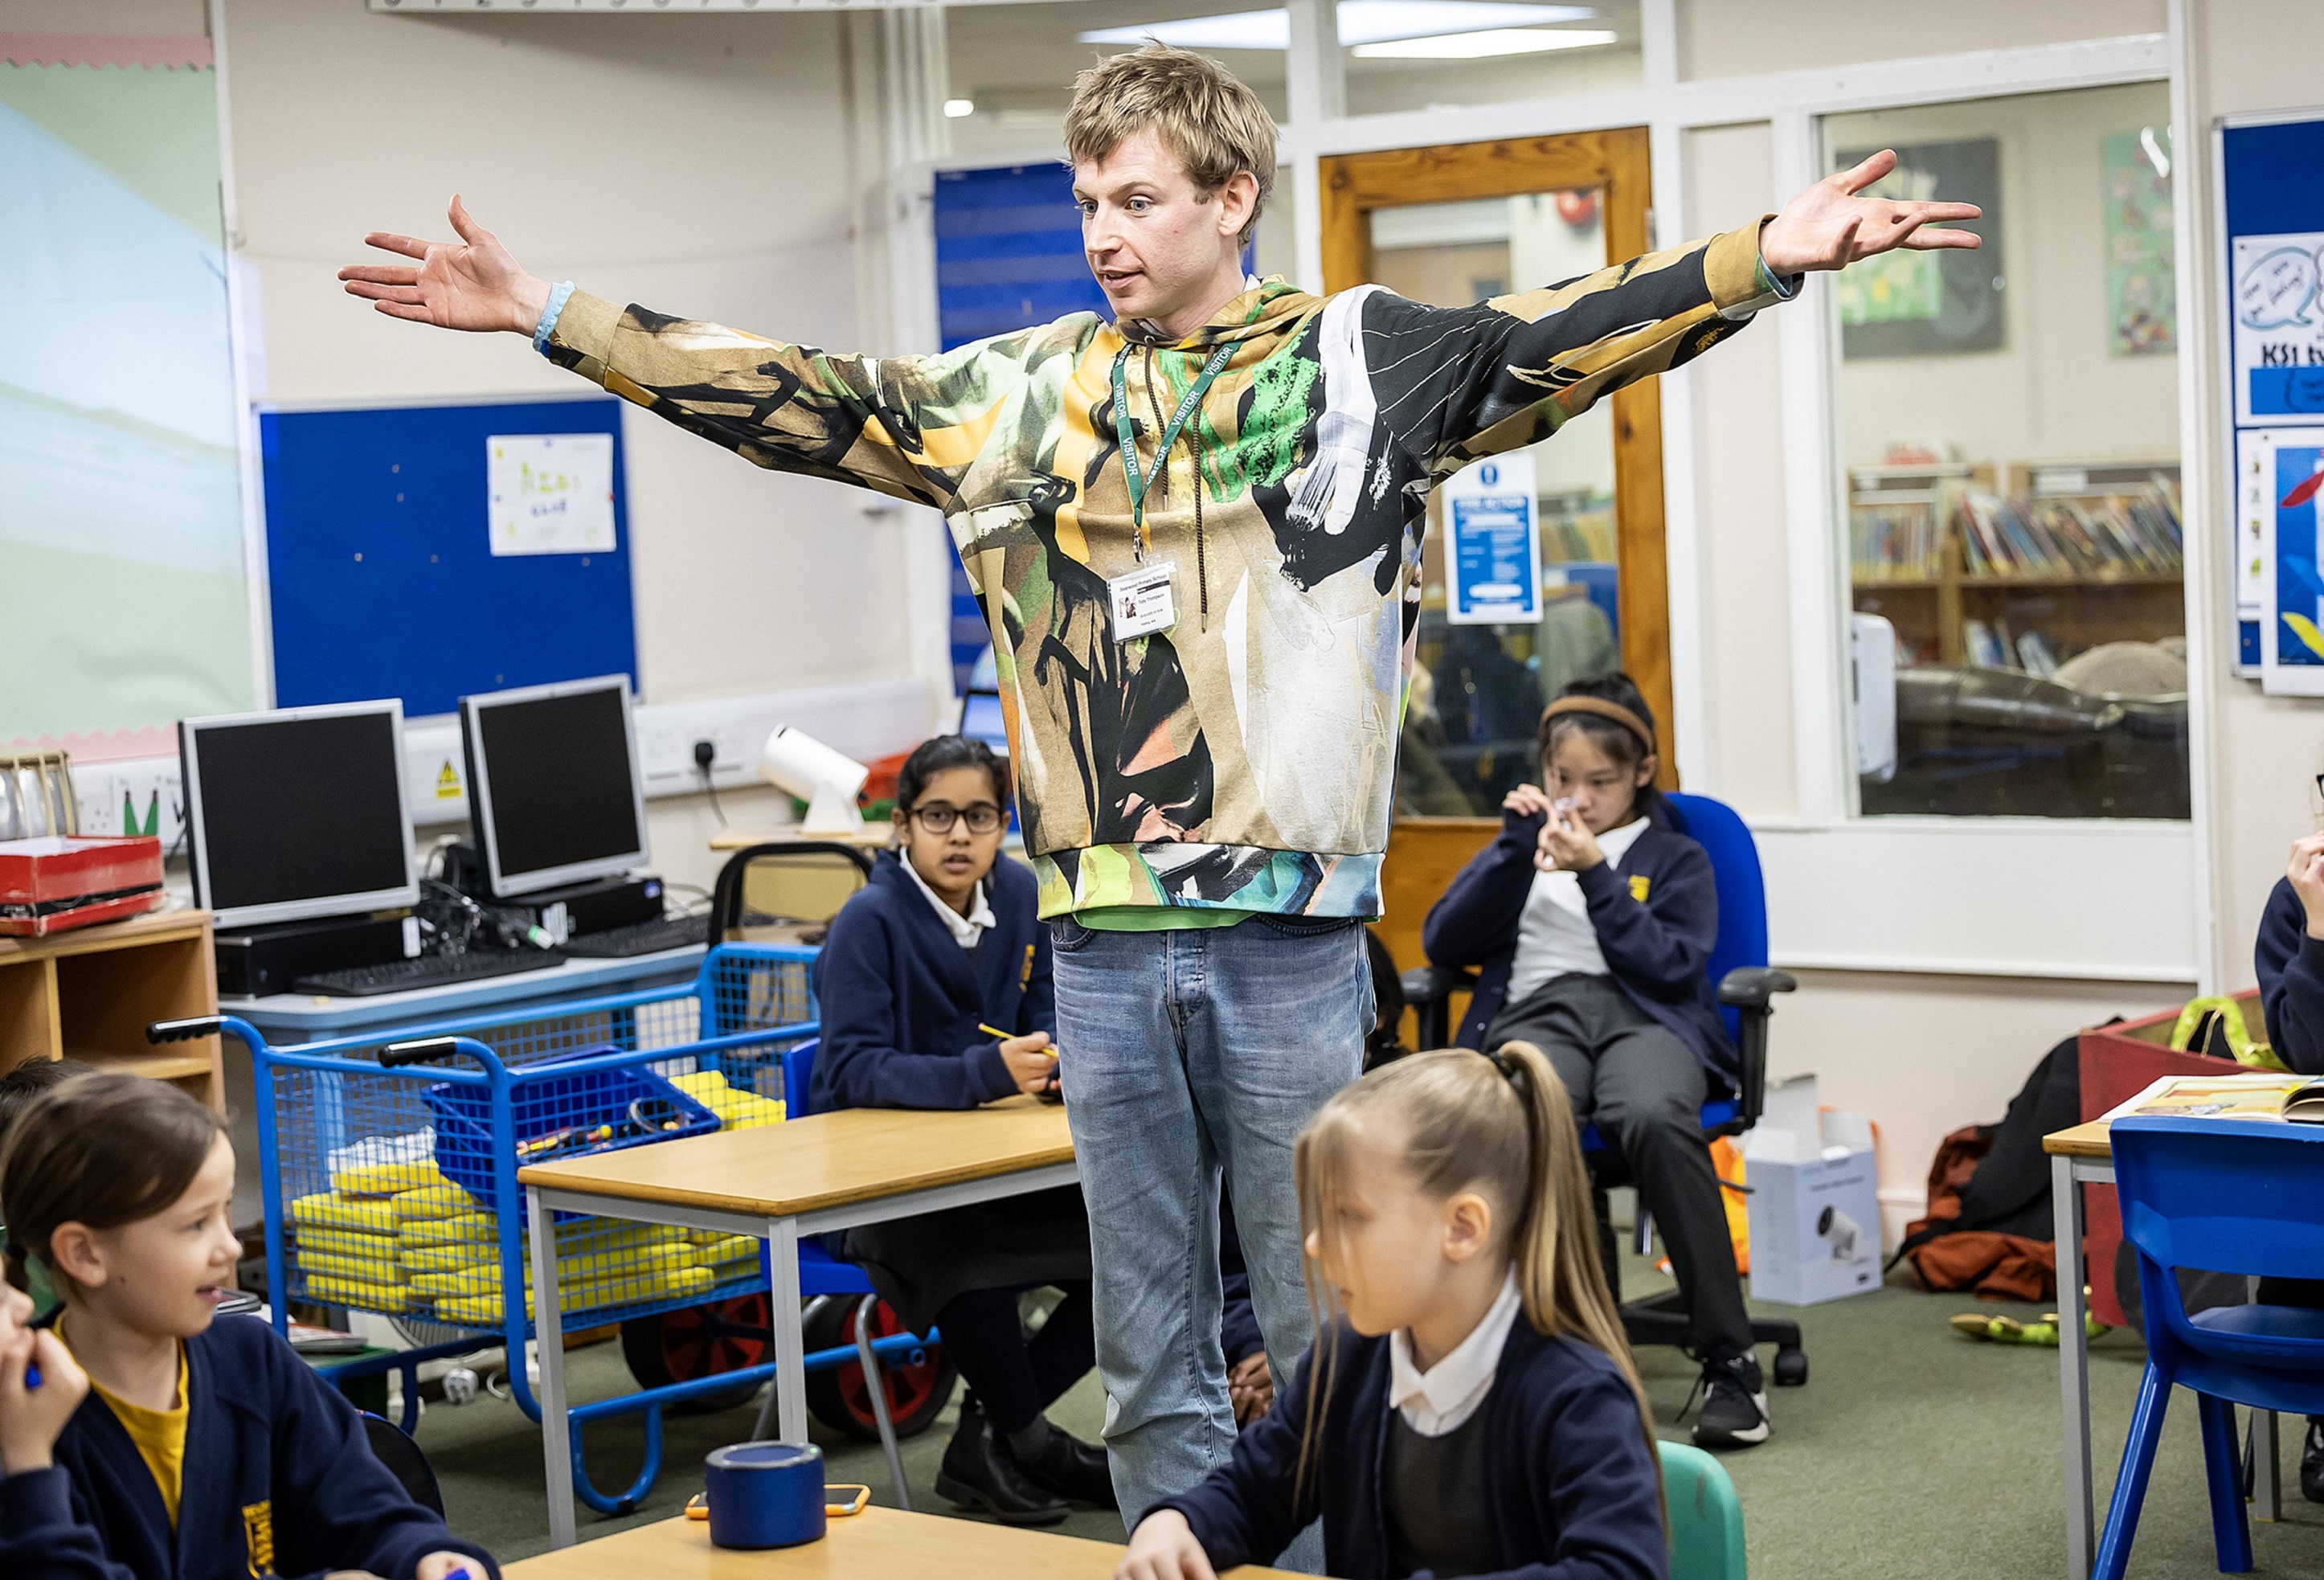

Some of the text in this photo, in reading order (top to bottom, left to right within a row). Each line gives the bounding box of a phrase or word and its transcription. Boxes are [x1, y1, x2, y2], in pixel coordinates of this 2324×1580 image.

[1115, 382, 1127, 420] VISITOR
[1123, 436, 1139, 477] VISITOR
[1147, 346, 1234, 485] VISITOR VISITOR VISITOR
